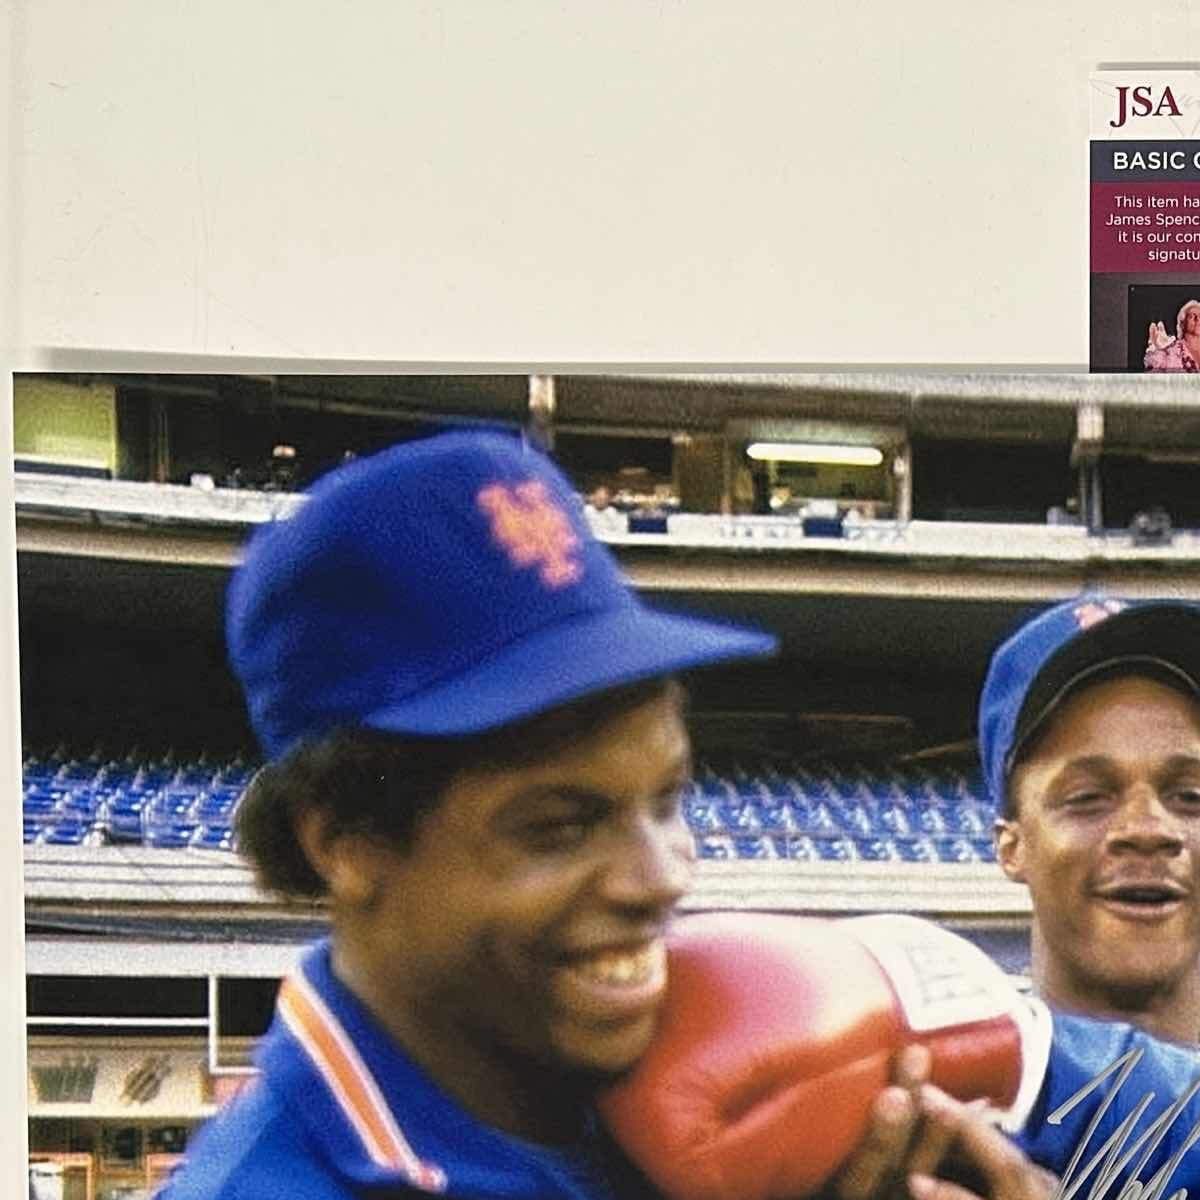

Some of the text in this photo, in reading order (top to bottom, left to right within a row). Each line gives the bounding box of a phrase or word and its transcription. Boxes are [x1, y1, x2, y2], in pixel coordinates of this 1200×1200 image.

[1110, 86, 1183, 127] JSA
[1113, 151, 1186, 170] BASIC
[1114, 195, 1143, 208] This
[1147, 195, 1179, 208] item
[1105, 213, 1151, 226] James
[1118, 230, 1128, 243] it
[1132, 230, 1143, 243] is
[1147, 232, 1171, 243] our
